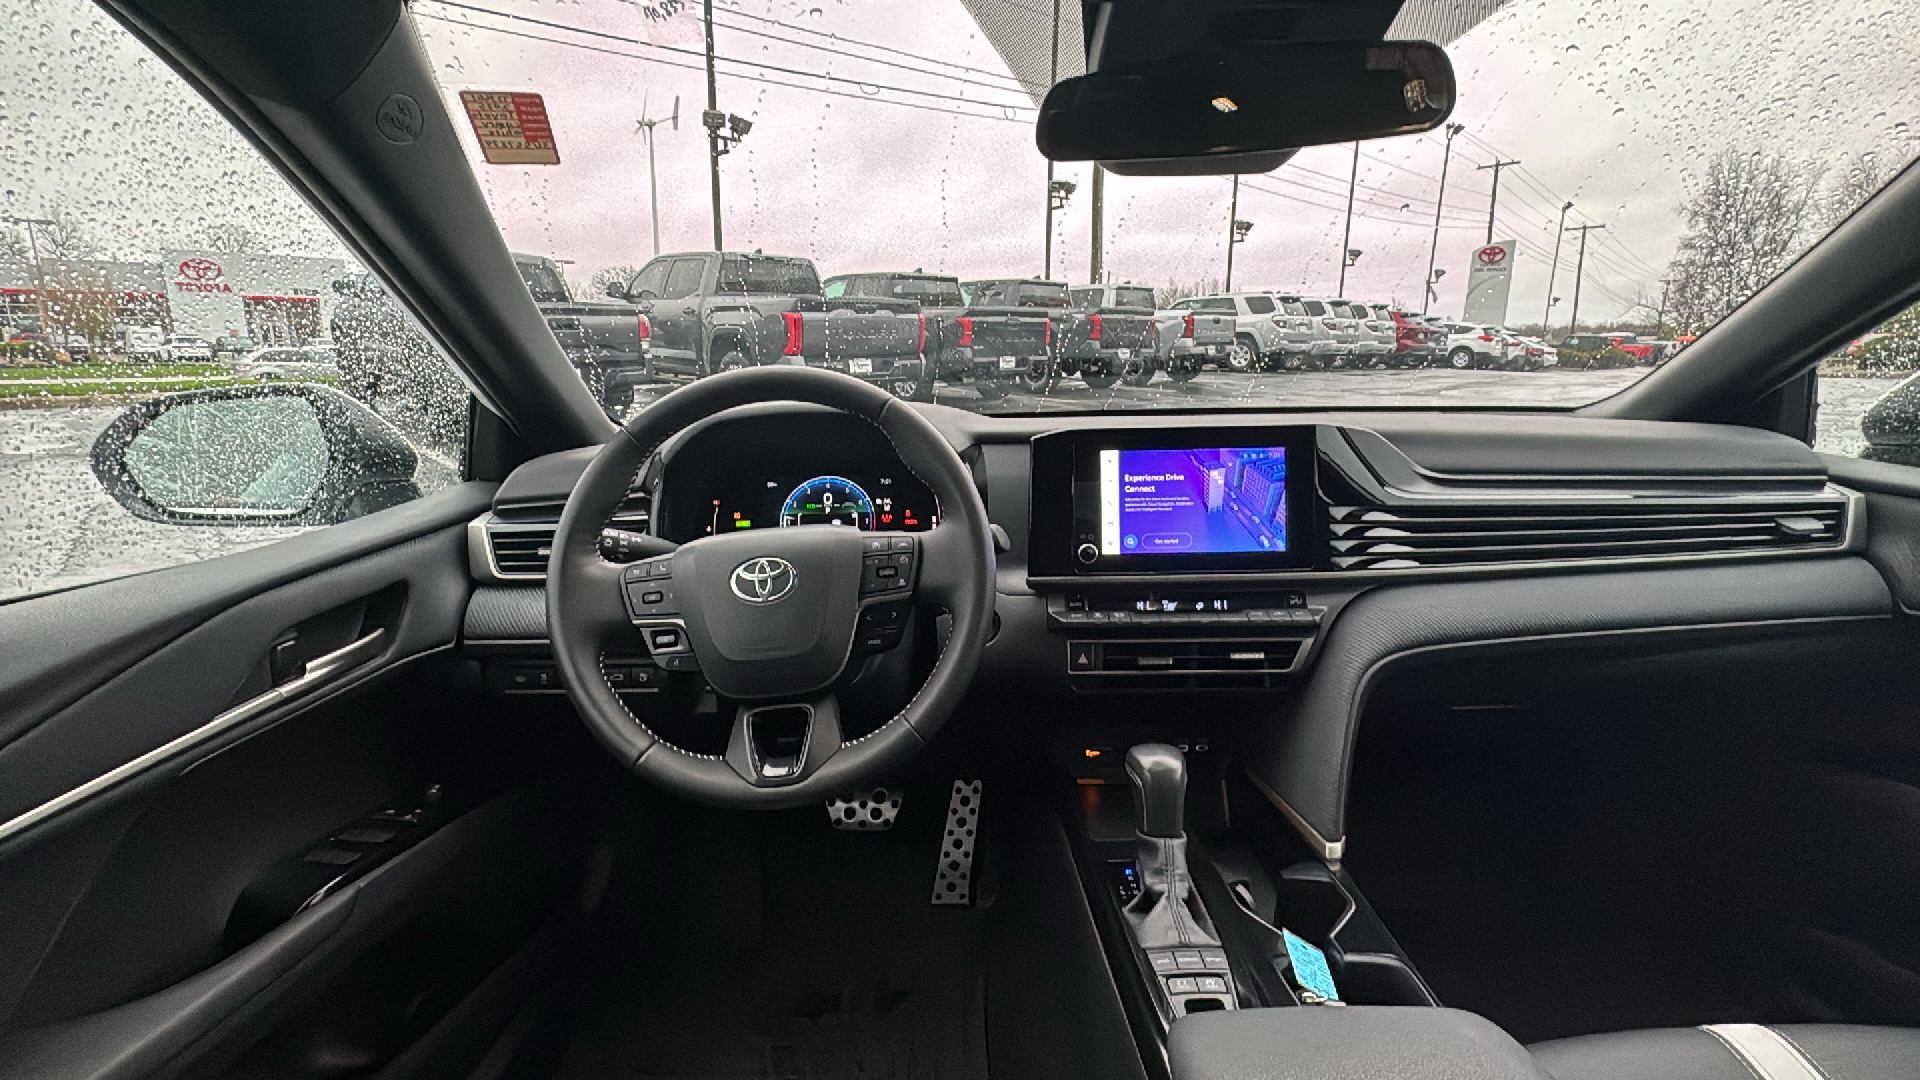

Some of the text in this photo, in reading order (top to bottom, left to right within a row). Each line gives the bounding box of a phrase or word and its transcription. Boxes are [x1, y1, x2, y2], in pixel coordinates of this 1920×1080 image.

[175, 281, 233, 294] TOYOTA
[1124, 473, 1185, 484] Experience Drive
[1124, 485, 1156, 493] Connect
